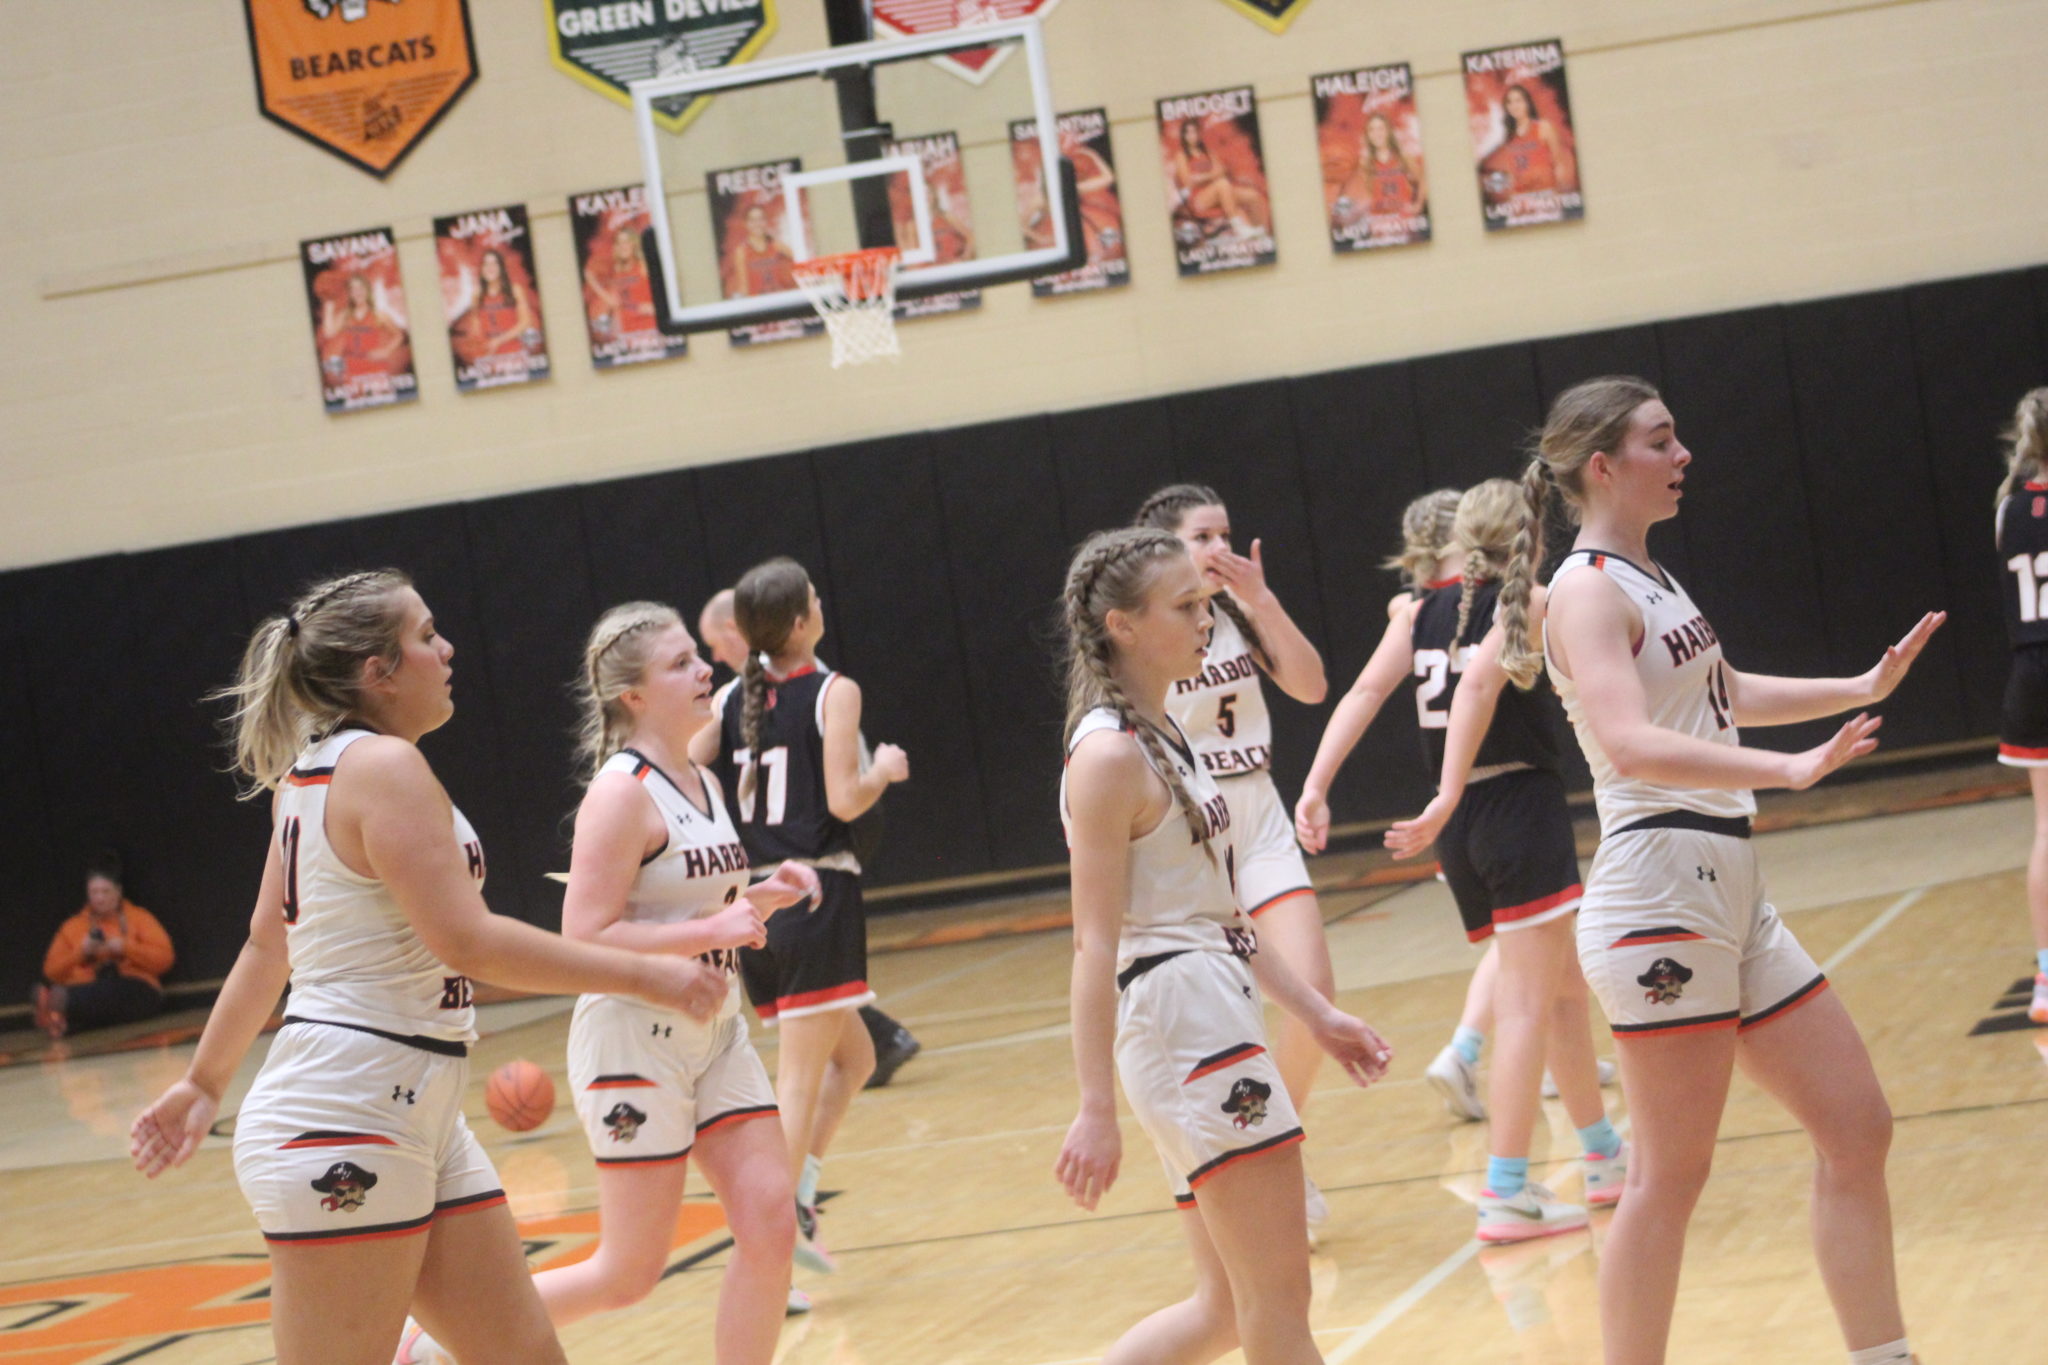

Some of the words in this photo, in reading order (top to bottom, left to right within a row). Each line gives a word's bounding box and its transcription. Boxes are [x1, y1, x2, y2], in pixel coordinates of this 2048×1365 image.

[558, 0, 656, 37] GREEN
[289, 34, 437, 81] BEARCATS
[1465, 43, 1561, 73] KATERINA
[1315, 68, 1410, 98] HALEIGH
[1160, 89, 1252, 121] BRIDGET
[1014, 113, 1105, 141] SANTHA
[450, 210, 513, 239] JANA
[308, 232, 392, 265] SAVANA
[1216, 693, 1236, 738] 5
[732, 745, 788, 825] 11
[683, 842, 751, 880] HARB
